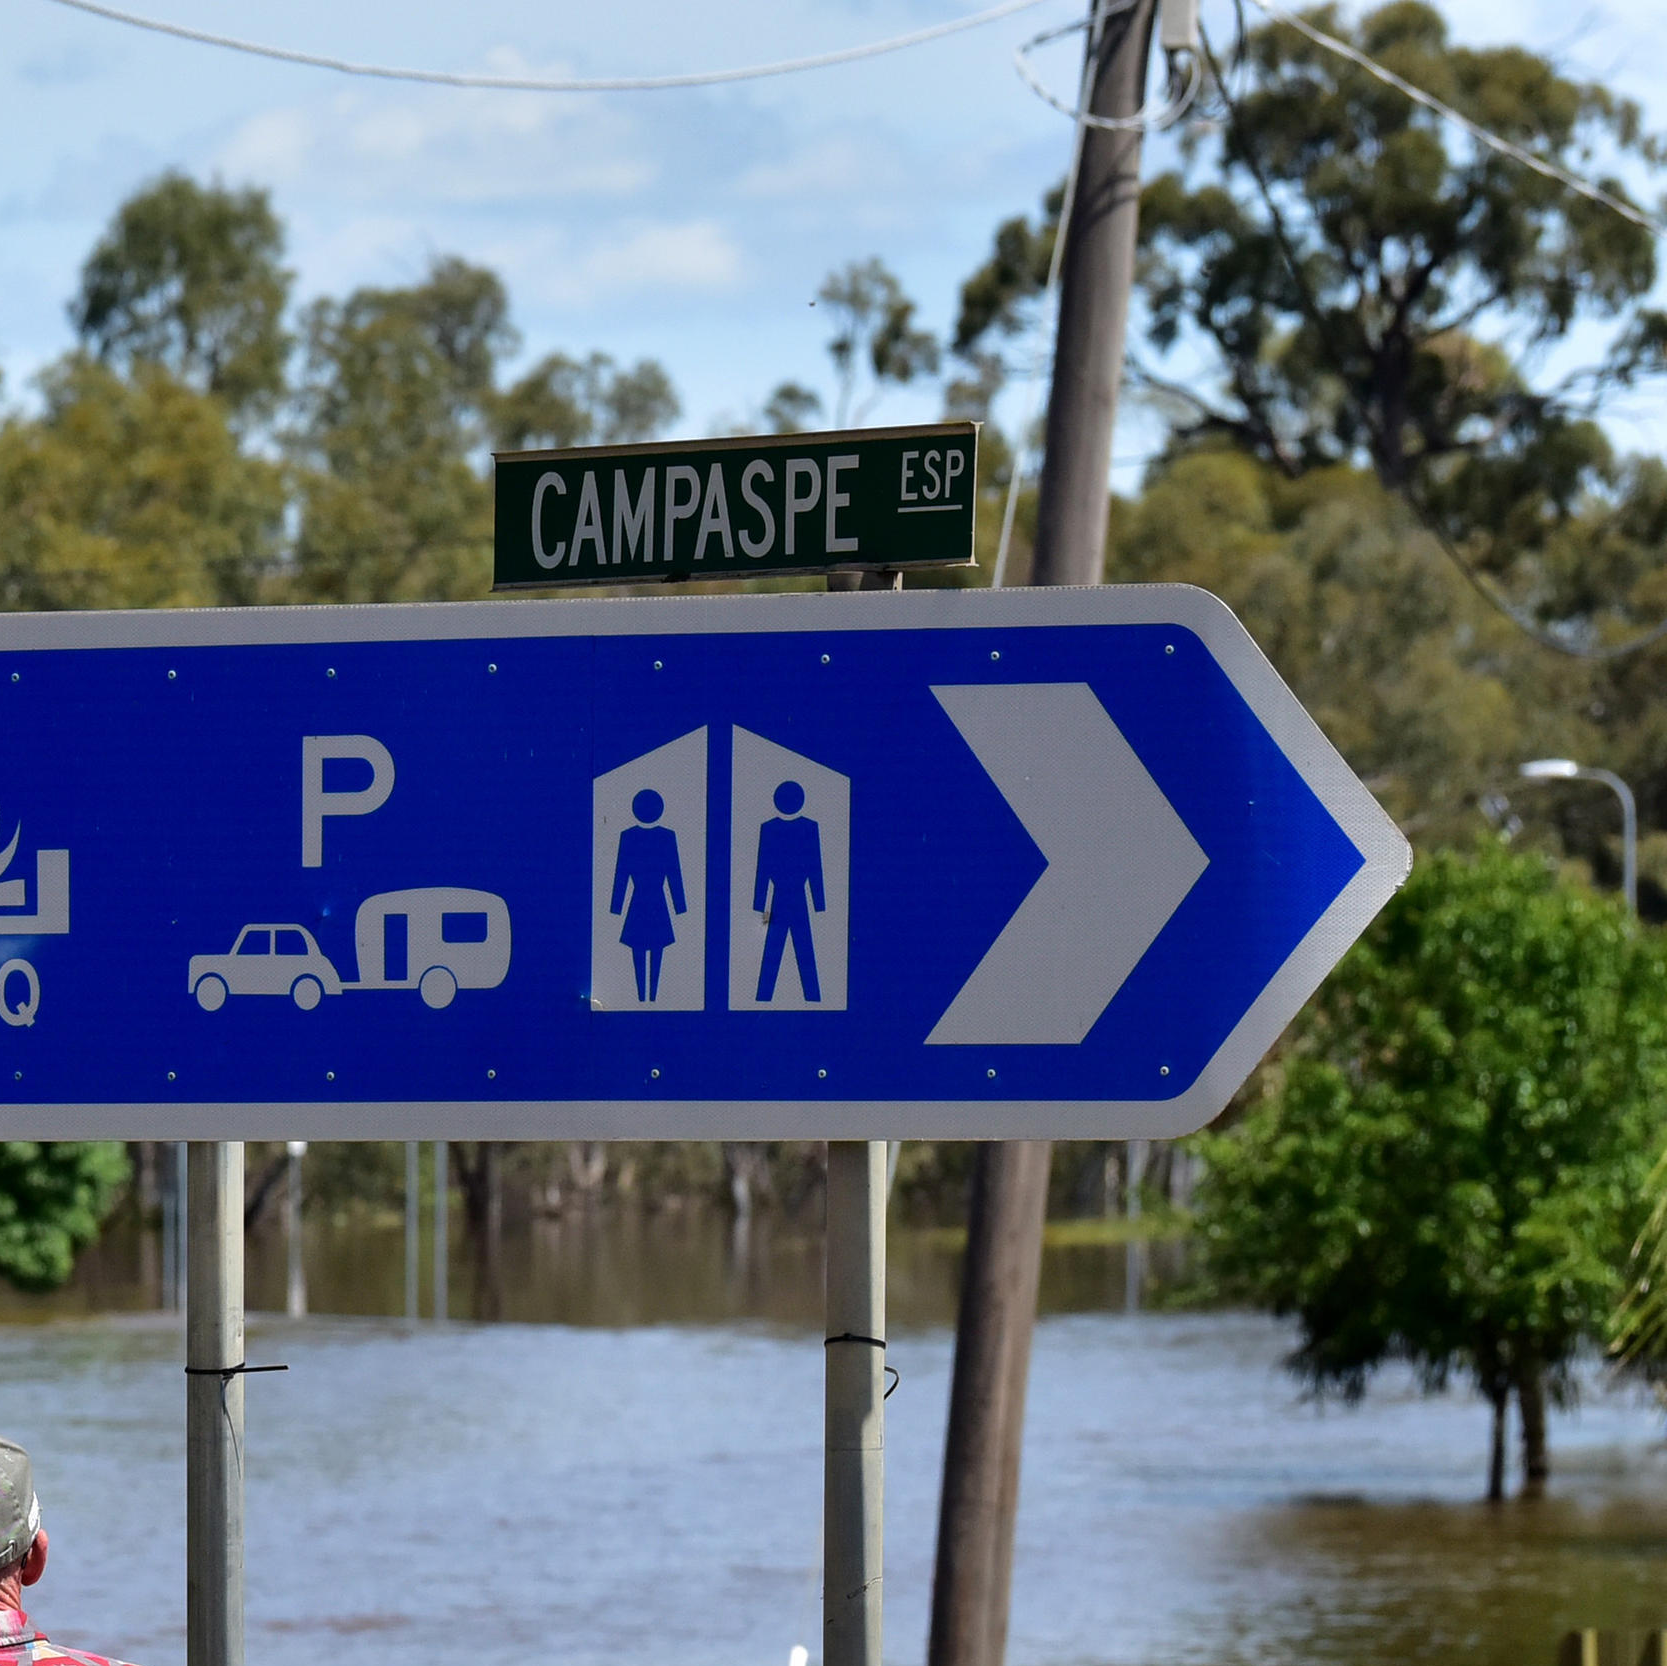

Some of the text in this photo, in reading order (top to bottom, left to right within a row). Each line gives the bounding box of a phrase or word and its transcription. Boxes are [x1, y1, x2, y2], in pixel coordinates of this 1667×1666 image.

[531, 448, 965, 570] CAMPASPE ESP
[301, 734, 396, 868] P
